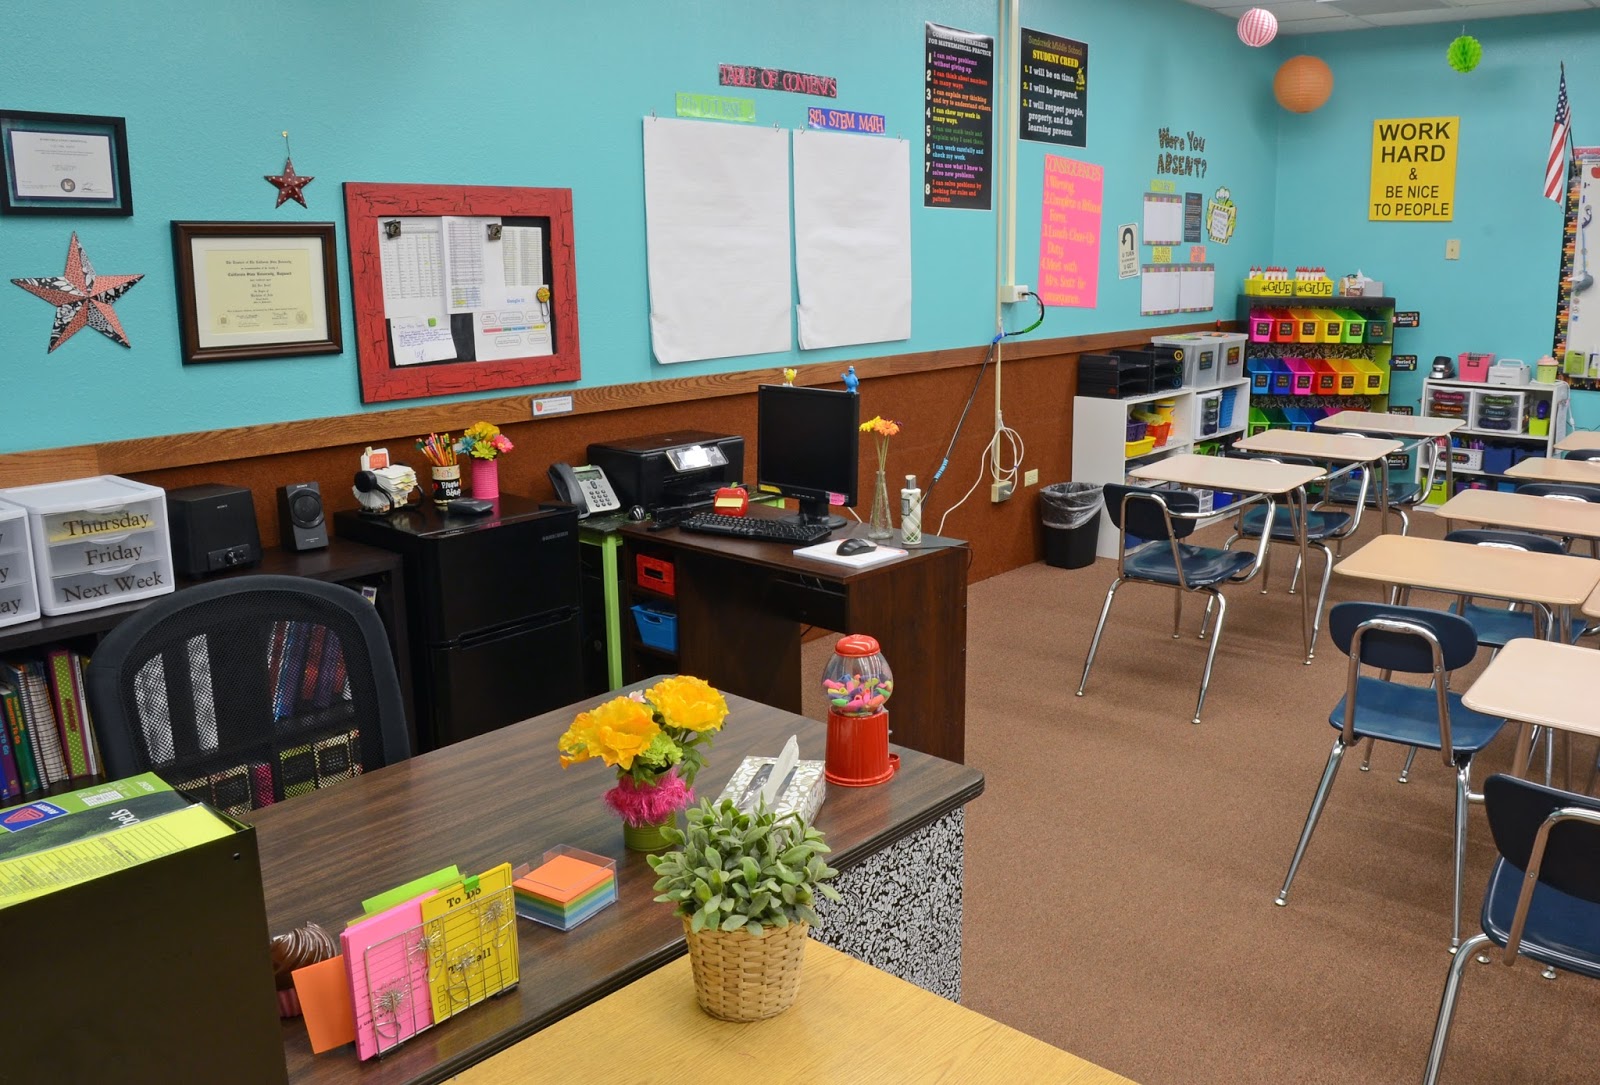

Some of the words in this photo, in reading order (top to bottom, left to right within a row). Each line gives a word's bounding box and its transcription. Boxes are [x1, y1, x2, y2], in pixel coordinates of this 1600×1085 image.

[972, 47, 992, 56] PRACTICE
[1033, 50, 1059, 64] STUDENT
[1060, 55, 1079, 68] CREED
[720, 65, 757, 88] TABLE
[761, 69, 778, 89] OF
[782, 72, 837, 98] CONTENTS
[927, 70, 932, 81] 2
[1024, 65, 1029, 73] 1.
[1033, 67, 1045, 77] will
[1046, 69, 1053, 79] be
[1054, 72, 1061, 80] on
[1061, 73, 1075, 83] time.
[926, 88, 932, 100] 3
[1023, 82, 1028, 90] 2.
[1033, 84, 1045, 93] will
[1046, 86, 1053, 95] be
[1053, 89, 1078, 100] prepared.
[926, 107, 931, 118] 4
[1023, 99, 1028, 107] 3.
[1033, 101, 1044, 110] will
[1045, 103, 1065, 114] respect
[1065, 107, 1084, 118] people,
[809, 108, 826, 126] 8th
[829, 111, 855, 129] STEM
[859, 114, 884, 133] MATH
[1028, 113, 1053, 124] property,
[1054, 116, 1064, 124] and
[1065, 117, 1073, 126] the
[926, 125, 931, 137] 5
[1028, 123, 1052, 136] learning
[1052, 128, 1073, 137] process.
[1379, 121, 1451, 141] WORK
[1158, 127, 1185, 151] Were
[1187, 131, 1205, 153] You
[926, 143, 931, 155] 6
[1381, 143, 1446, 163] HARD
[1157, 152, 1207, 179] ABSENT?
[1408, 167, 1418, 181] &
[926, 183, 931, 195] 8
[1386, 185, 1404, 199] BE
[1407, 185, 1439, 199] NICE
[1374, 203, 1391, 217] TO
[1395, 202, 1449, 217] PEOPLE
[63, 513, 149, 537] Thursday
[85, 546, 143, 566] Friday
[62, 583, 110, 603] Next
[114, 572, 164, 591] Week
[33, 803, 59, 816] AVERY
[109, 808, 140, 828] bels
[447, 897, 461, 908] To
